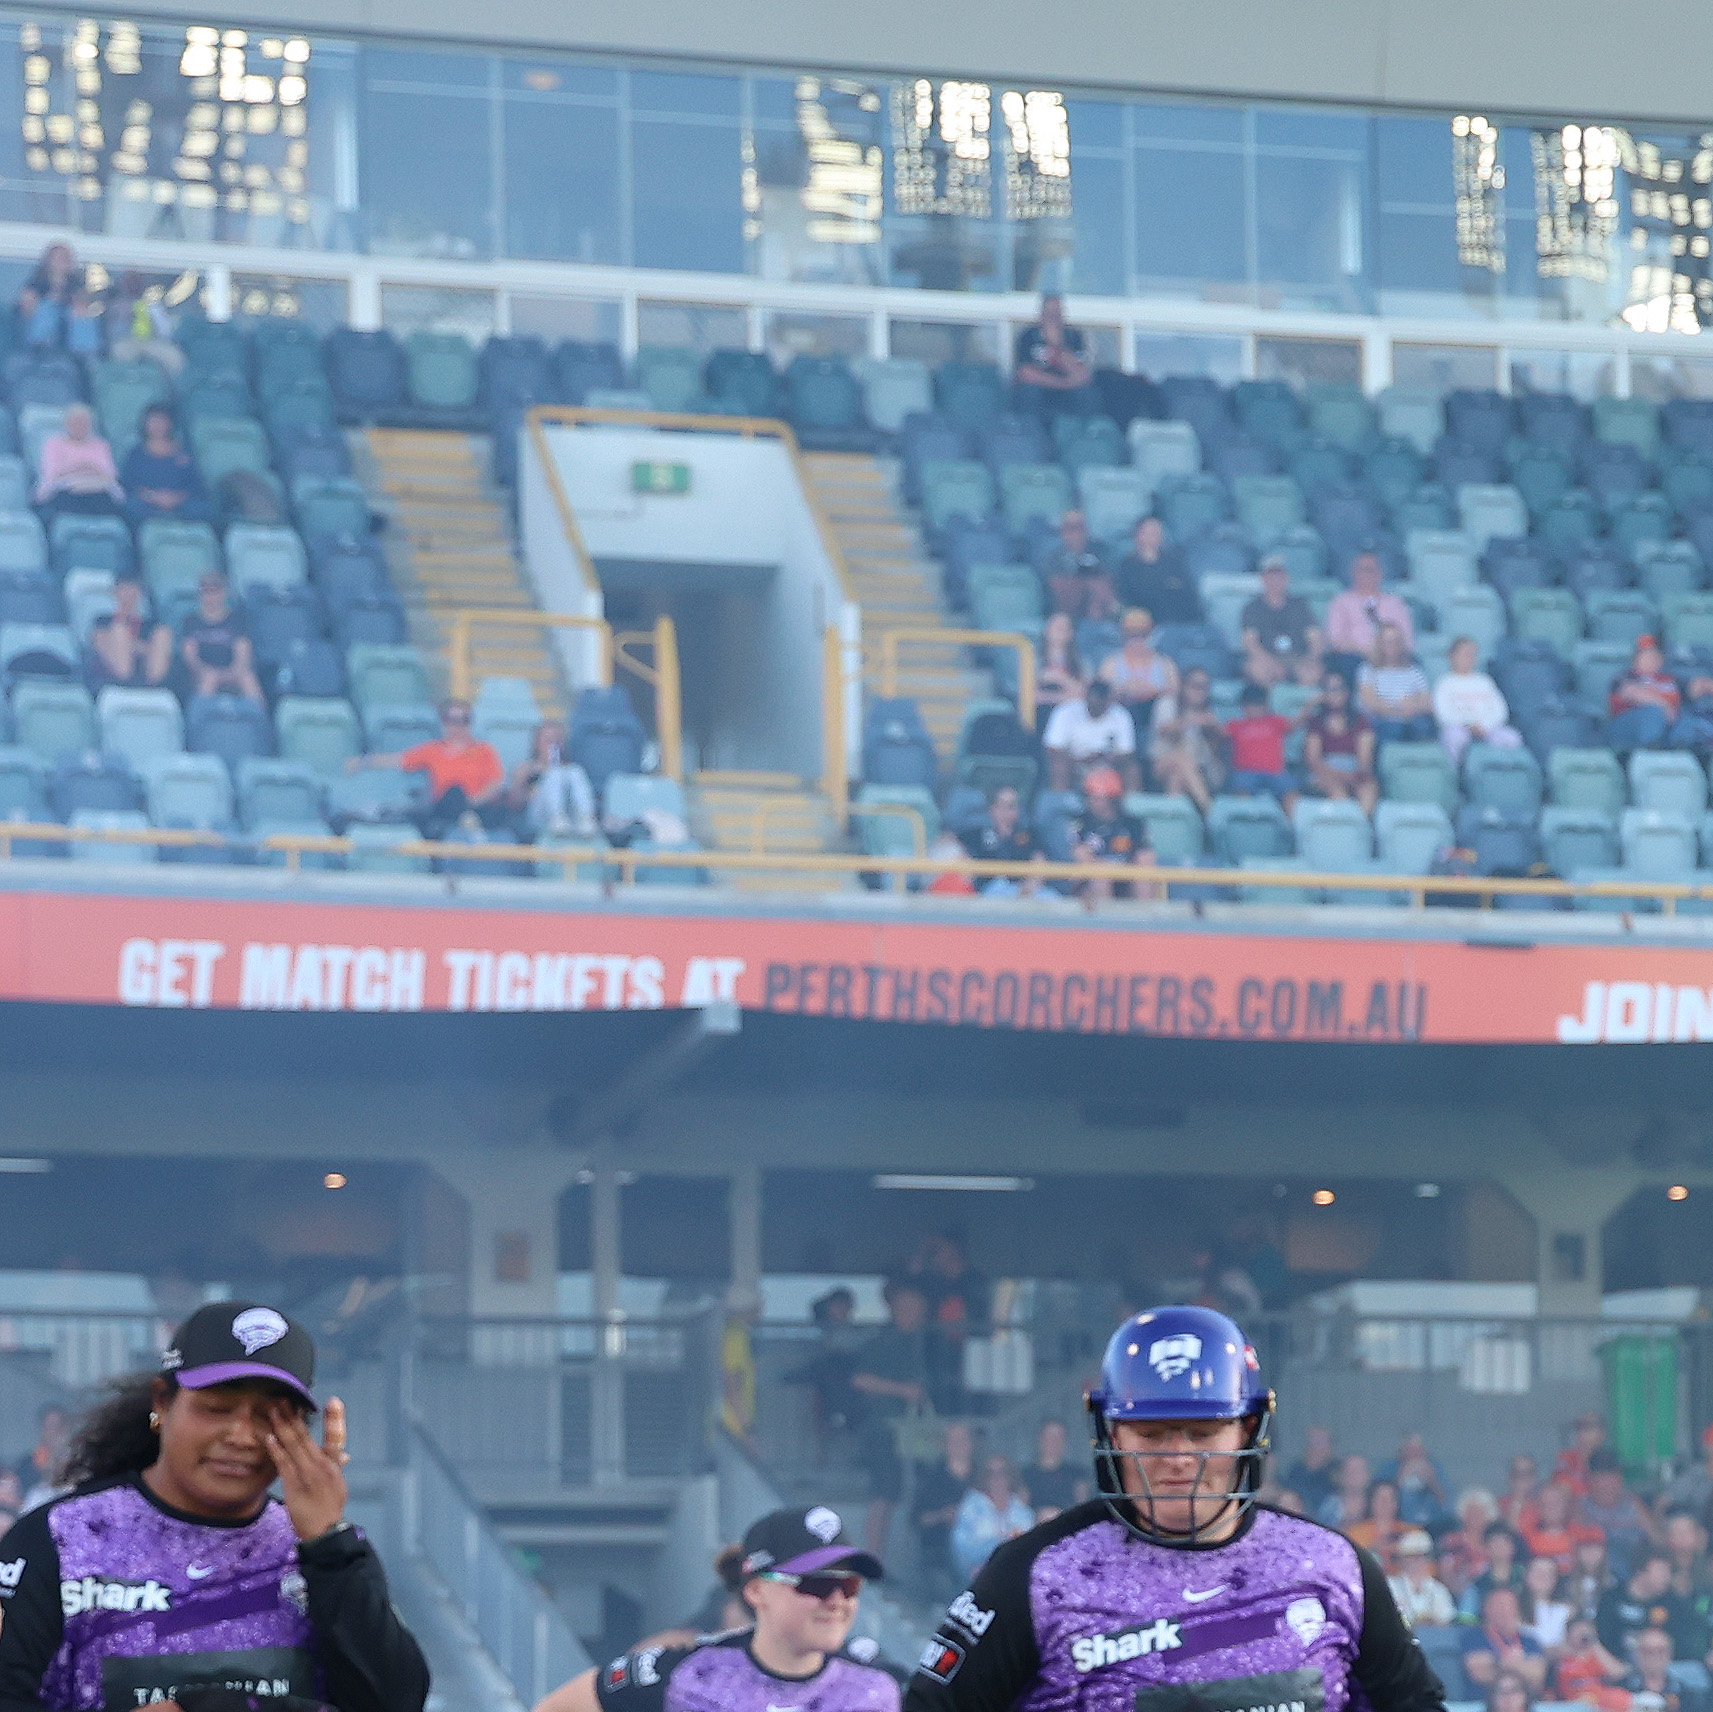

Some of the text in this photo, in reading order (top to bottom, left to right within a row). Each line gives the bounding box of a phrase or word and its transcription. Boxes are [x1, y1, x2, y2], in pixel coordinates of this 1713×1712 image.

[119, 938, 745, 1013] GET MATCH TICKETS AT
[765, 962, 1429, 1039] PERTHSCORCHERS.COM.AU
[61, 1575, 172, 1615] Shark
[1072, 1618, 1183, 1674] Shark
